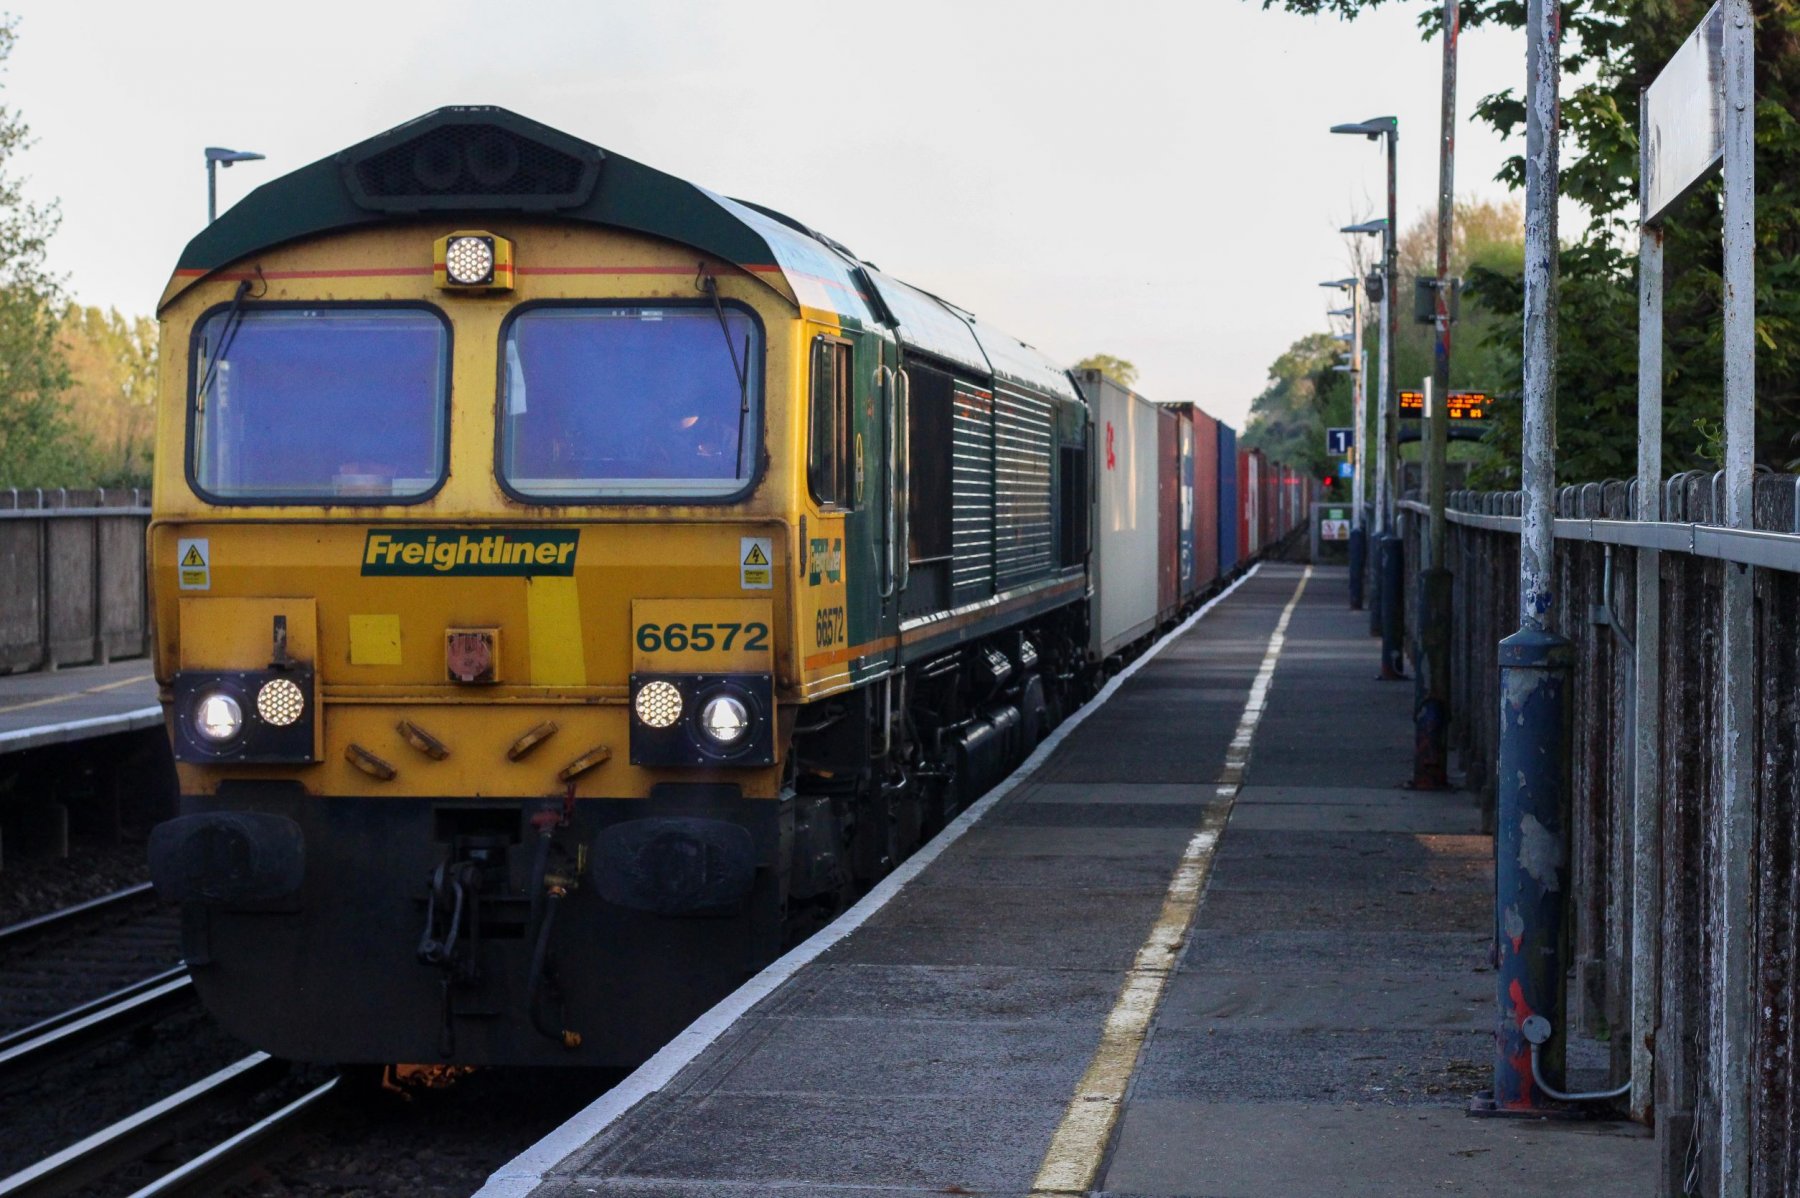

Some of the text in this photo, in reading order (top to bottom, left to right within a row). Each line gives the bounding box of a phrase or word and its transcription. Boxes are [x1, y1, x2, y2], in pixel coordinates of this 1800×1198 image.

[1336, 432, 1345, 452] 1
[366, 535, 575, 571] Freightliner
[636, 623, 768, 652] 66572
[816, 606, 843, 648] 66572
